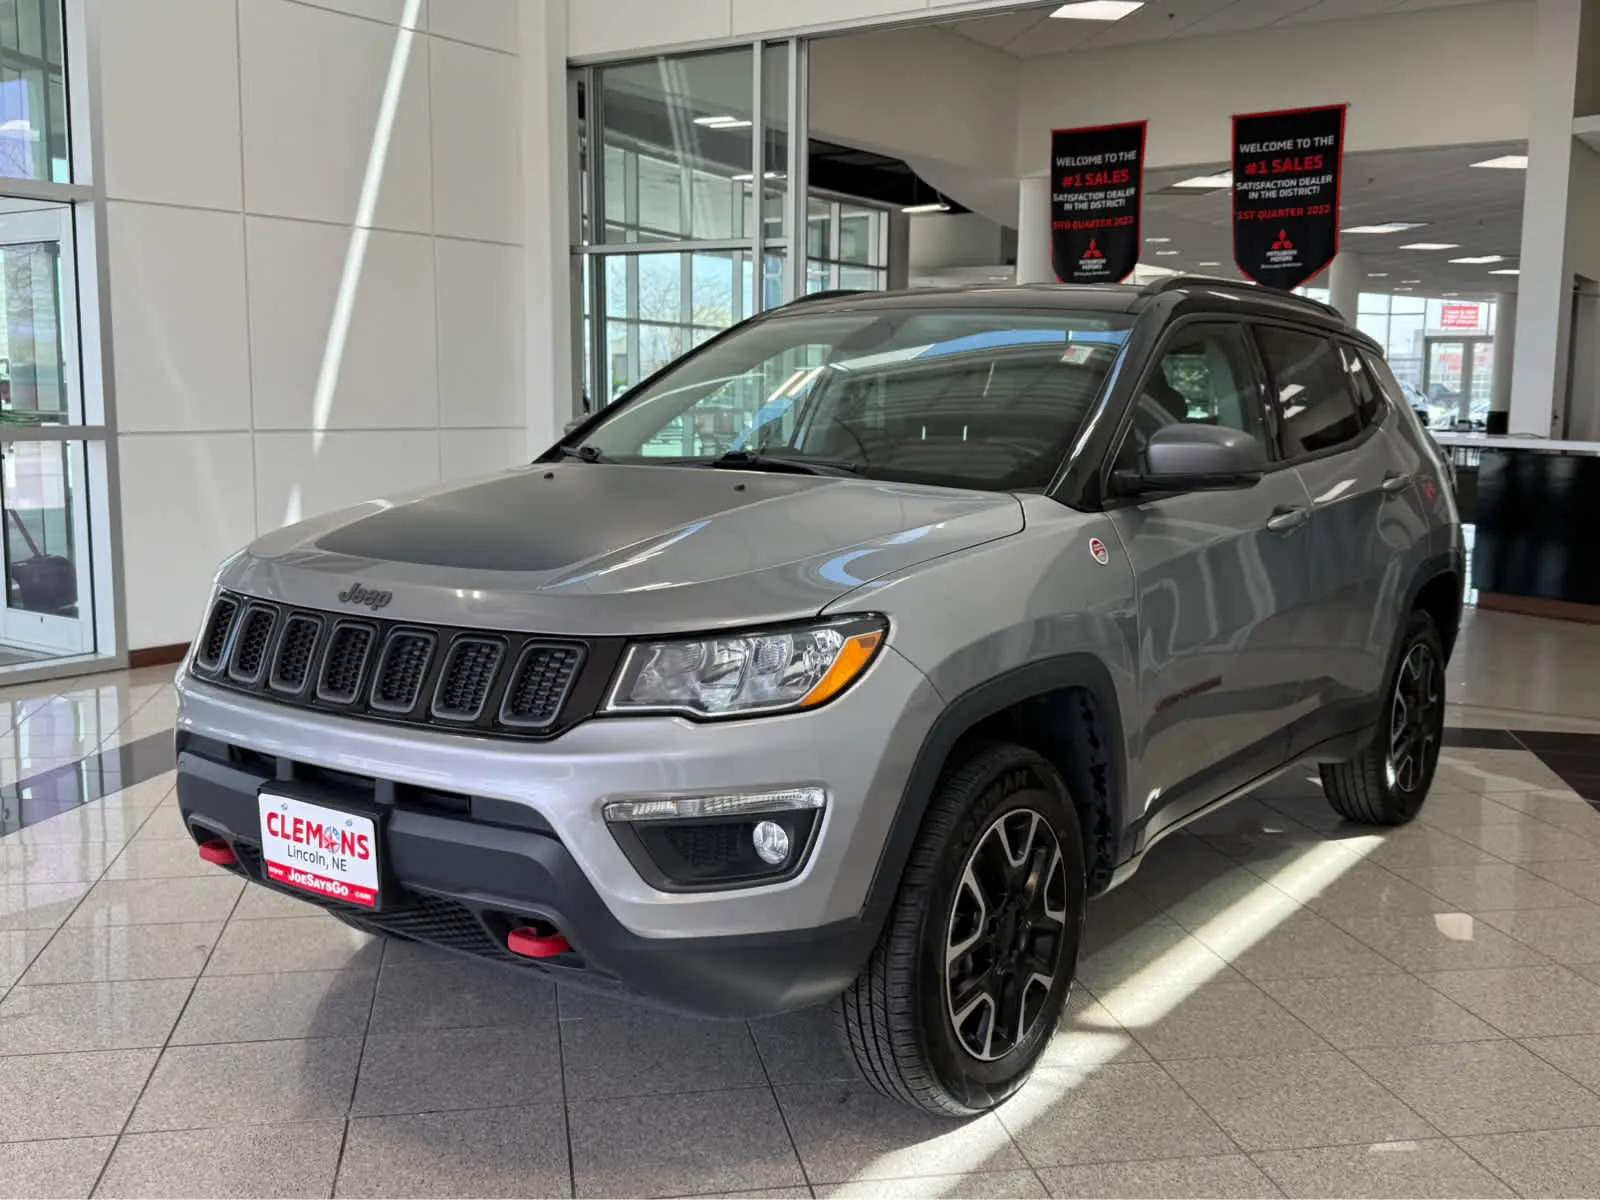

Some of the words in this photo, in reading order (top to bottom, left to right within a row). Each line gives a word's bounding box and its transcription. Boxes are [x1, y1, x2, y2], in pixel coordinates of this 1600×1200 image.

[1239, 139, 1293, 153] WELCOME
[1295, 138, 1311, 148] TO
[1313, 135, 1334, 146] THE
[1056, 155, 1103, 167] WELCOME
[1104, 153, 1117, 163] TO
[1118, 150, 1136, 161] THE
[1245, 161, 1268, 175] #1
[1272, 155, 1324, 174] SALES
[1063, 174, 1082, 188] #1
[1085, 169, 1129, 187] SALES
[1236, 179, 1297, 191] SATISFACTION
[1299, 175, 1333, 186] DEALER
[1053, 191, 1105, 202] SATISFACTION
[1106, 187, 1136, 199] DEALER
[1248, 191, 1258, 200] IN
[1261, 190, 1277, 199] THE
[1074, 202, 1089, 210] THE
[1238, 210, 1255, 220] 1ST
[1257, 208, 1304, 220] QUARTER
[338, 582, 393, 611] Jeep
[266, 811, 370, 860] CLEMONS
[287, 844, 329, 870] Lincoln,
[332, 857, 348, 872] NE
